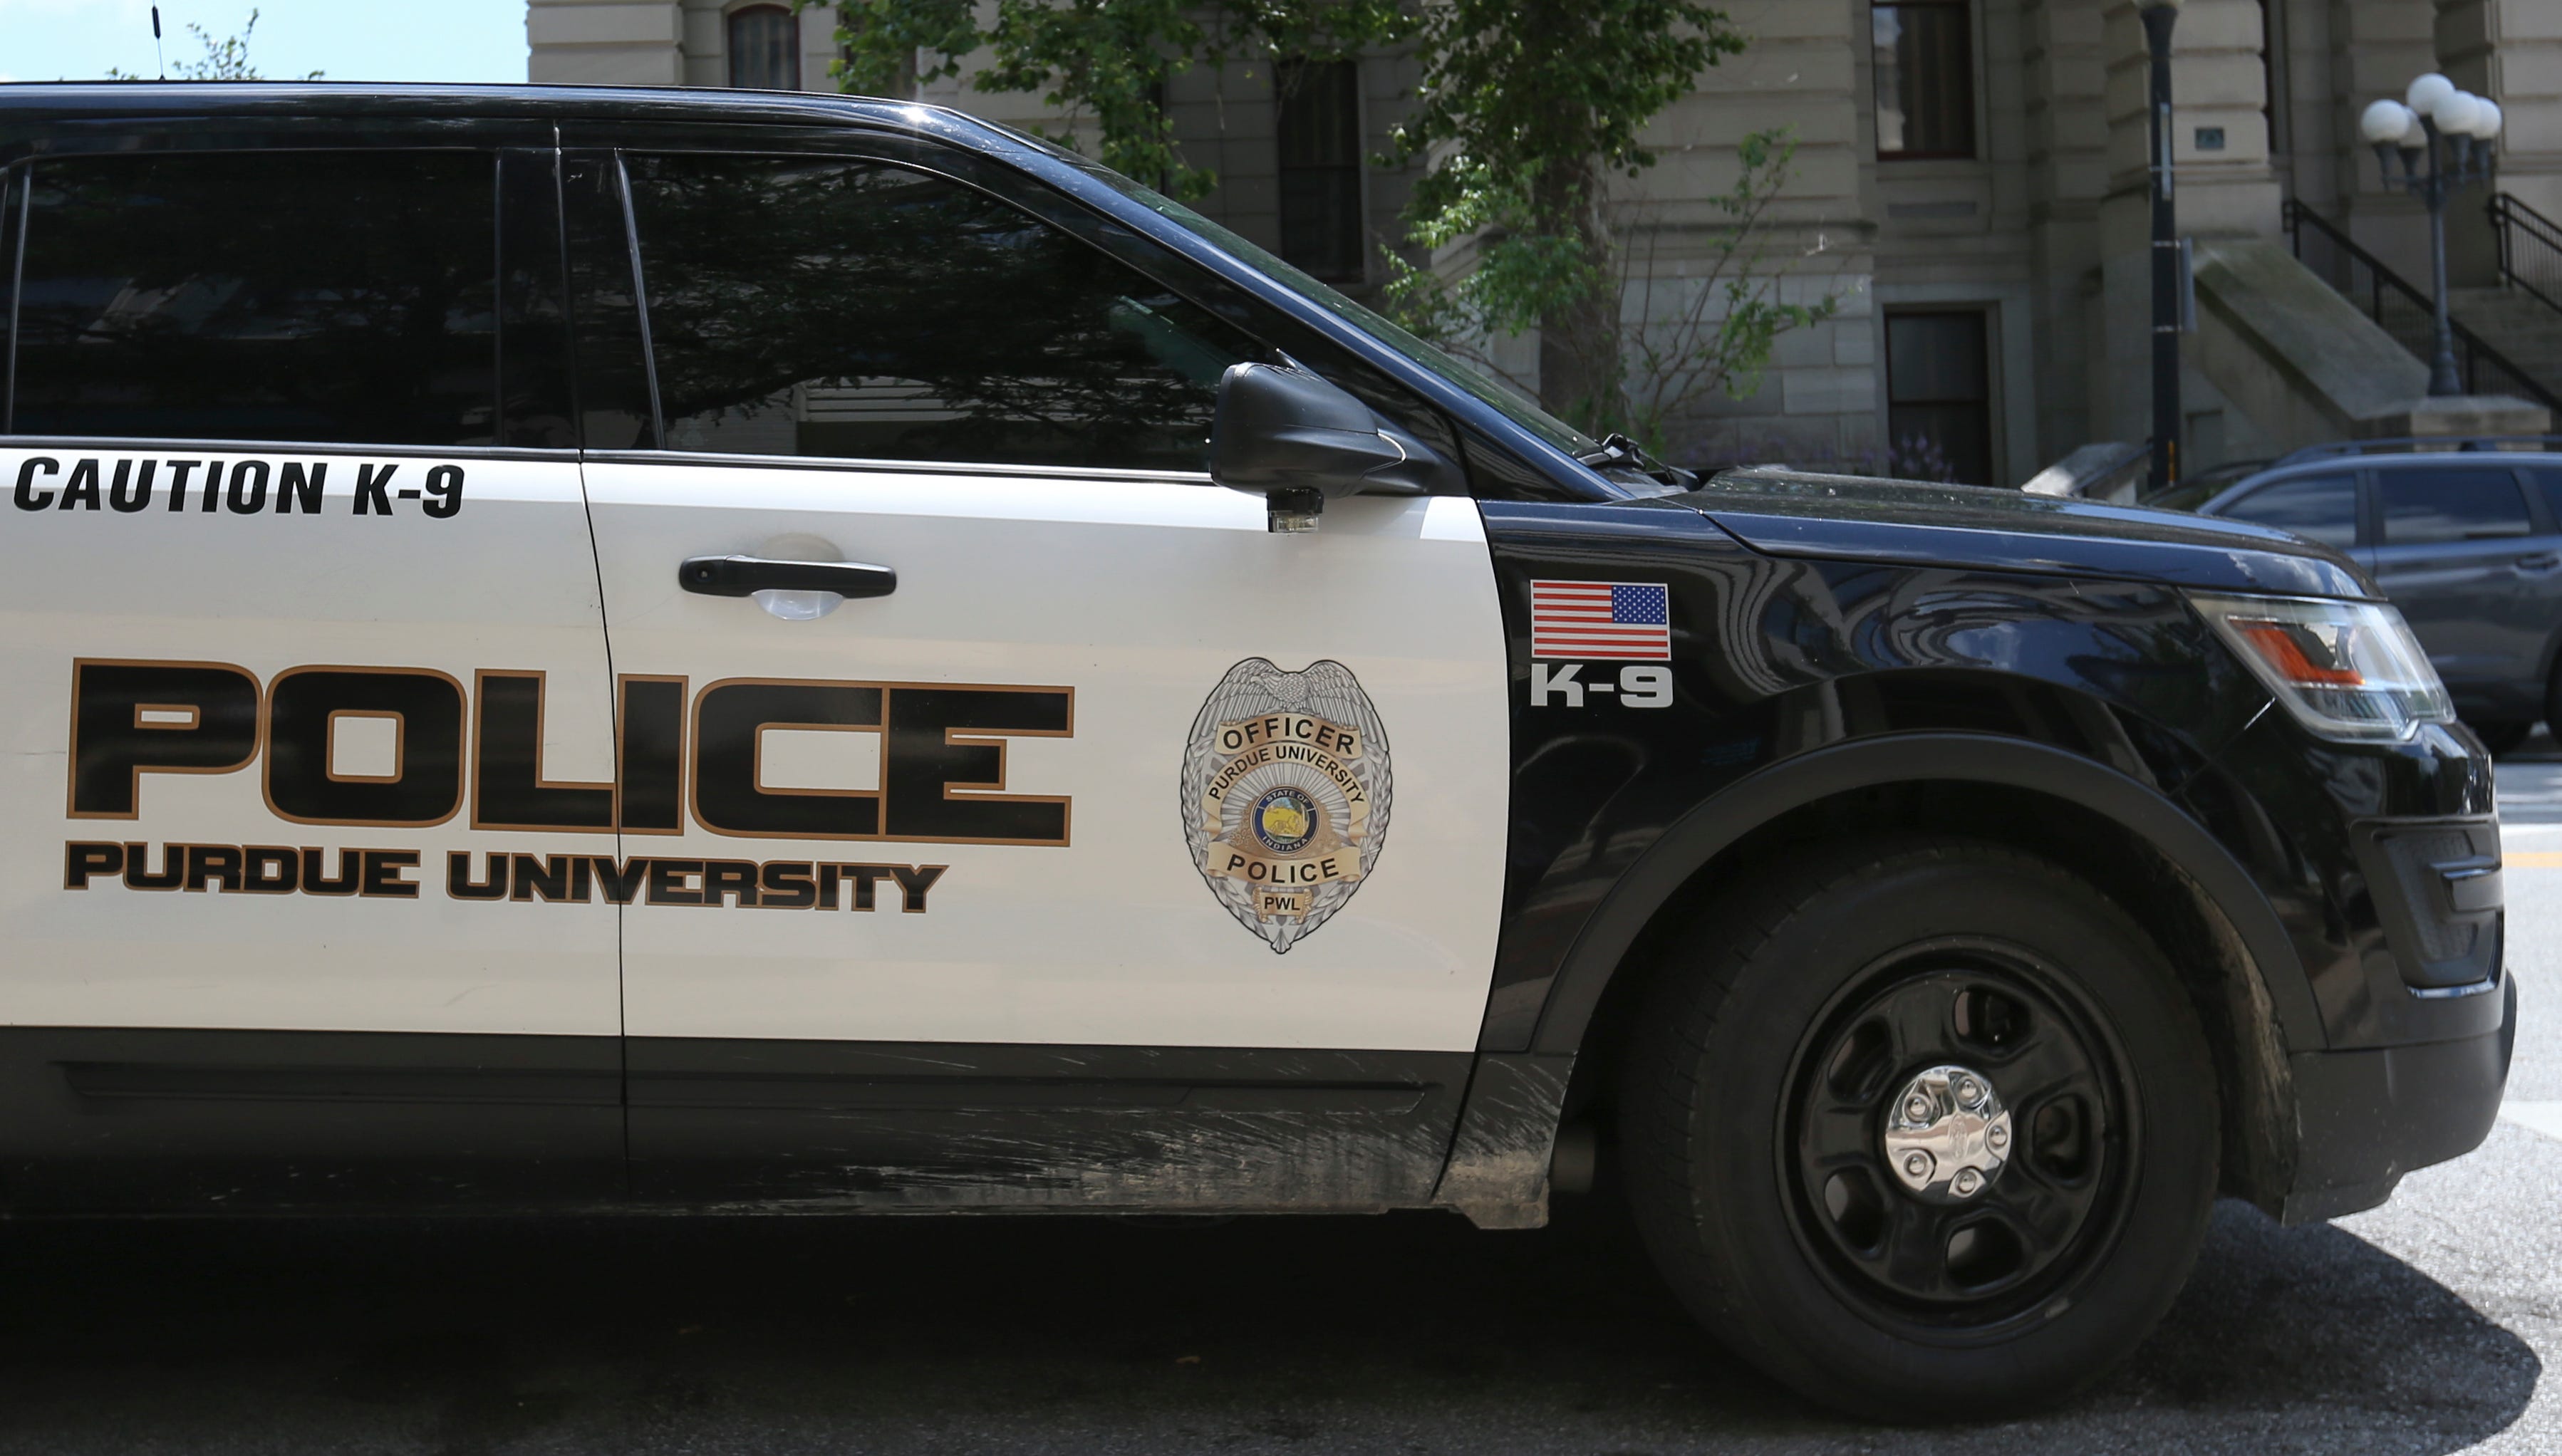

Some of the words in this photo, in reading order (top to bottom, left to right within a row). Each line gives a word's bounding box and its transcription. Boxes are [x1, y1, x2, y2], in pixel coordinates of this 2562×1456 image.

[13, 457, 328, 514] CAUTION
[352, 462, 466, 519] K-9
[1530, 663, 1674, 709] K-9
[66, 657, 1075, 847] POLICE
[1223, 717, 1354, 755] OFFICER
[1208, 747, 1271, 801] PURDUE
[1275, 745, 1365, 804] UNIVERSITY
[1265, 789, 1295, 803] STATE
[1297, 794, 1311, 805] OF
[1262, 835, 1309, 851] INDIANA
[63, 841, 421, 899] PURDUE
[445, 850, 950, 913] UNIVERSITY
[1226, 853, 1339, 884] POLICE
[1264, 896, 1301, 911] PWL
